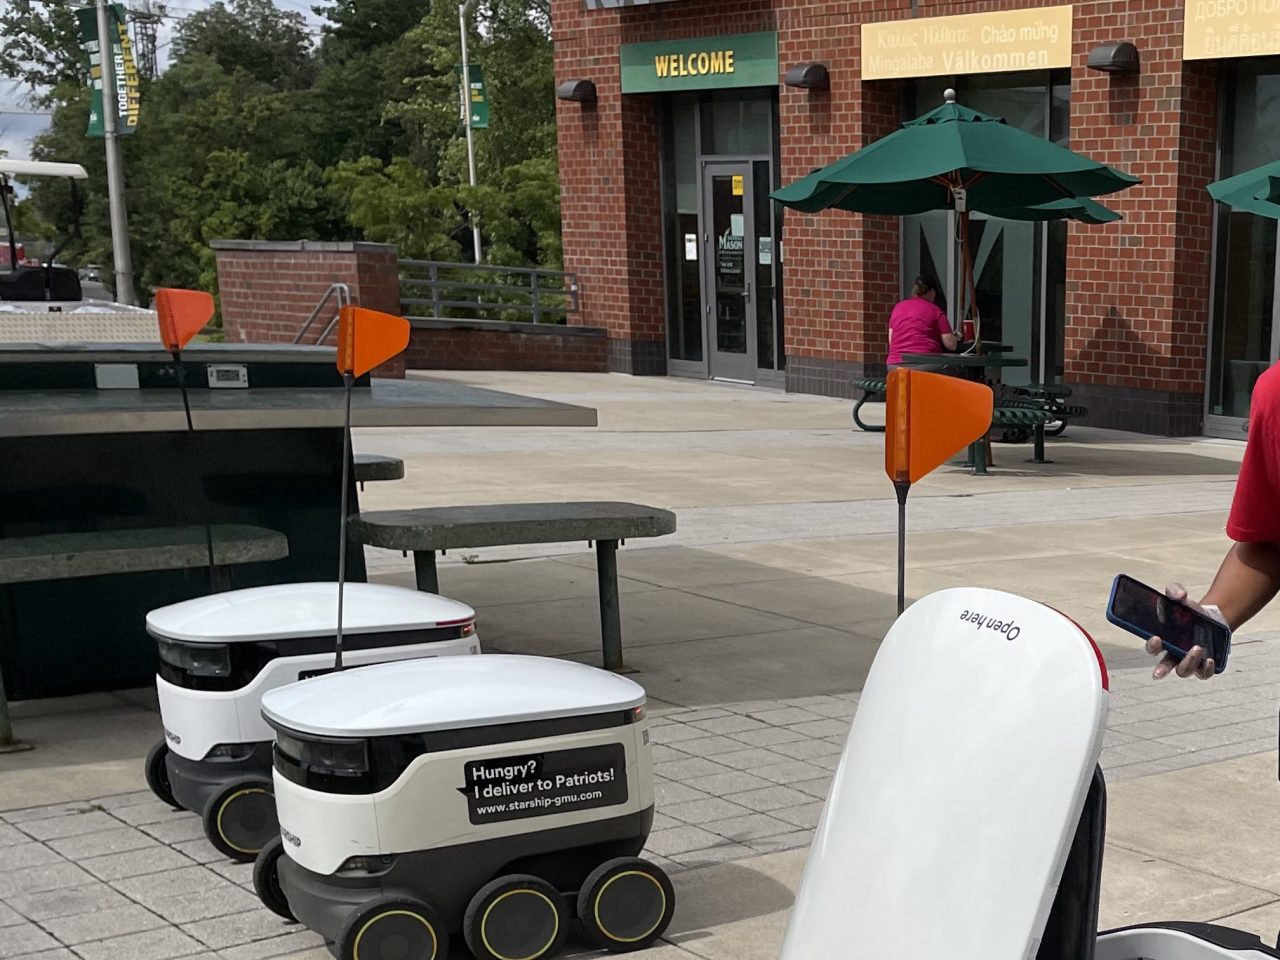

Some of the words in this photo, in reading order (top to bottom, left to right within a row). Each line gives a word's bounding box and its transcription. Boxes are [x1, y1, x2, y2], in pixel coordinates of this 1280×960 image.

[655, 50, 735, 77] WELCOME
[942, 48, 1048, 71] Välkommen
[114, 55, 128, 117] TOGETHER
[118, 21, 140, 126] DIFFERENT
[960, 610, 988, 630] here
[986, 618, 1021, 641] Open
[472, 760, 537, 780] Hungry?
[474, 785, 479, 799] I
[483, 781, 535, 798] deliver
[536, 779, 553, 791] to
[556, 768, 615, 788] Patriots!
[476, 790, 602, 815] www.starship-gmu.com
